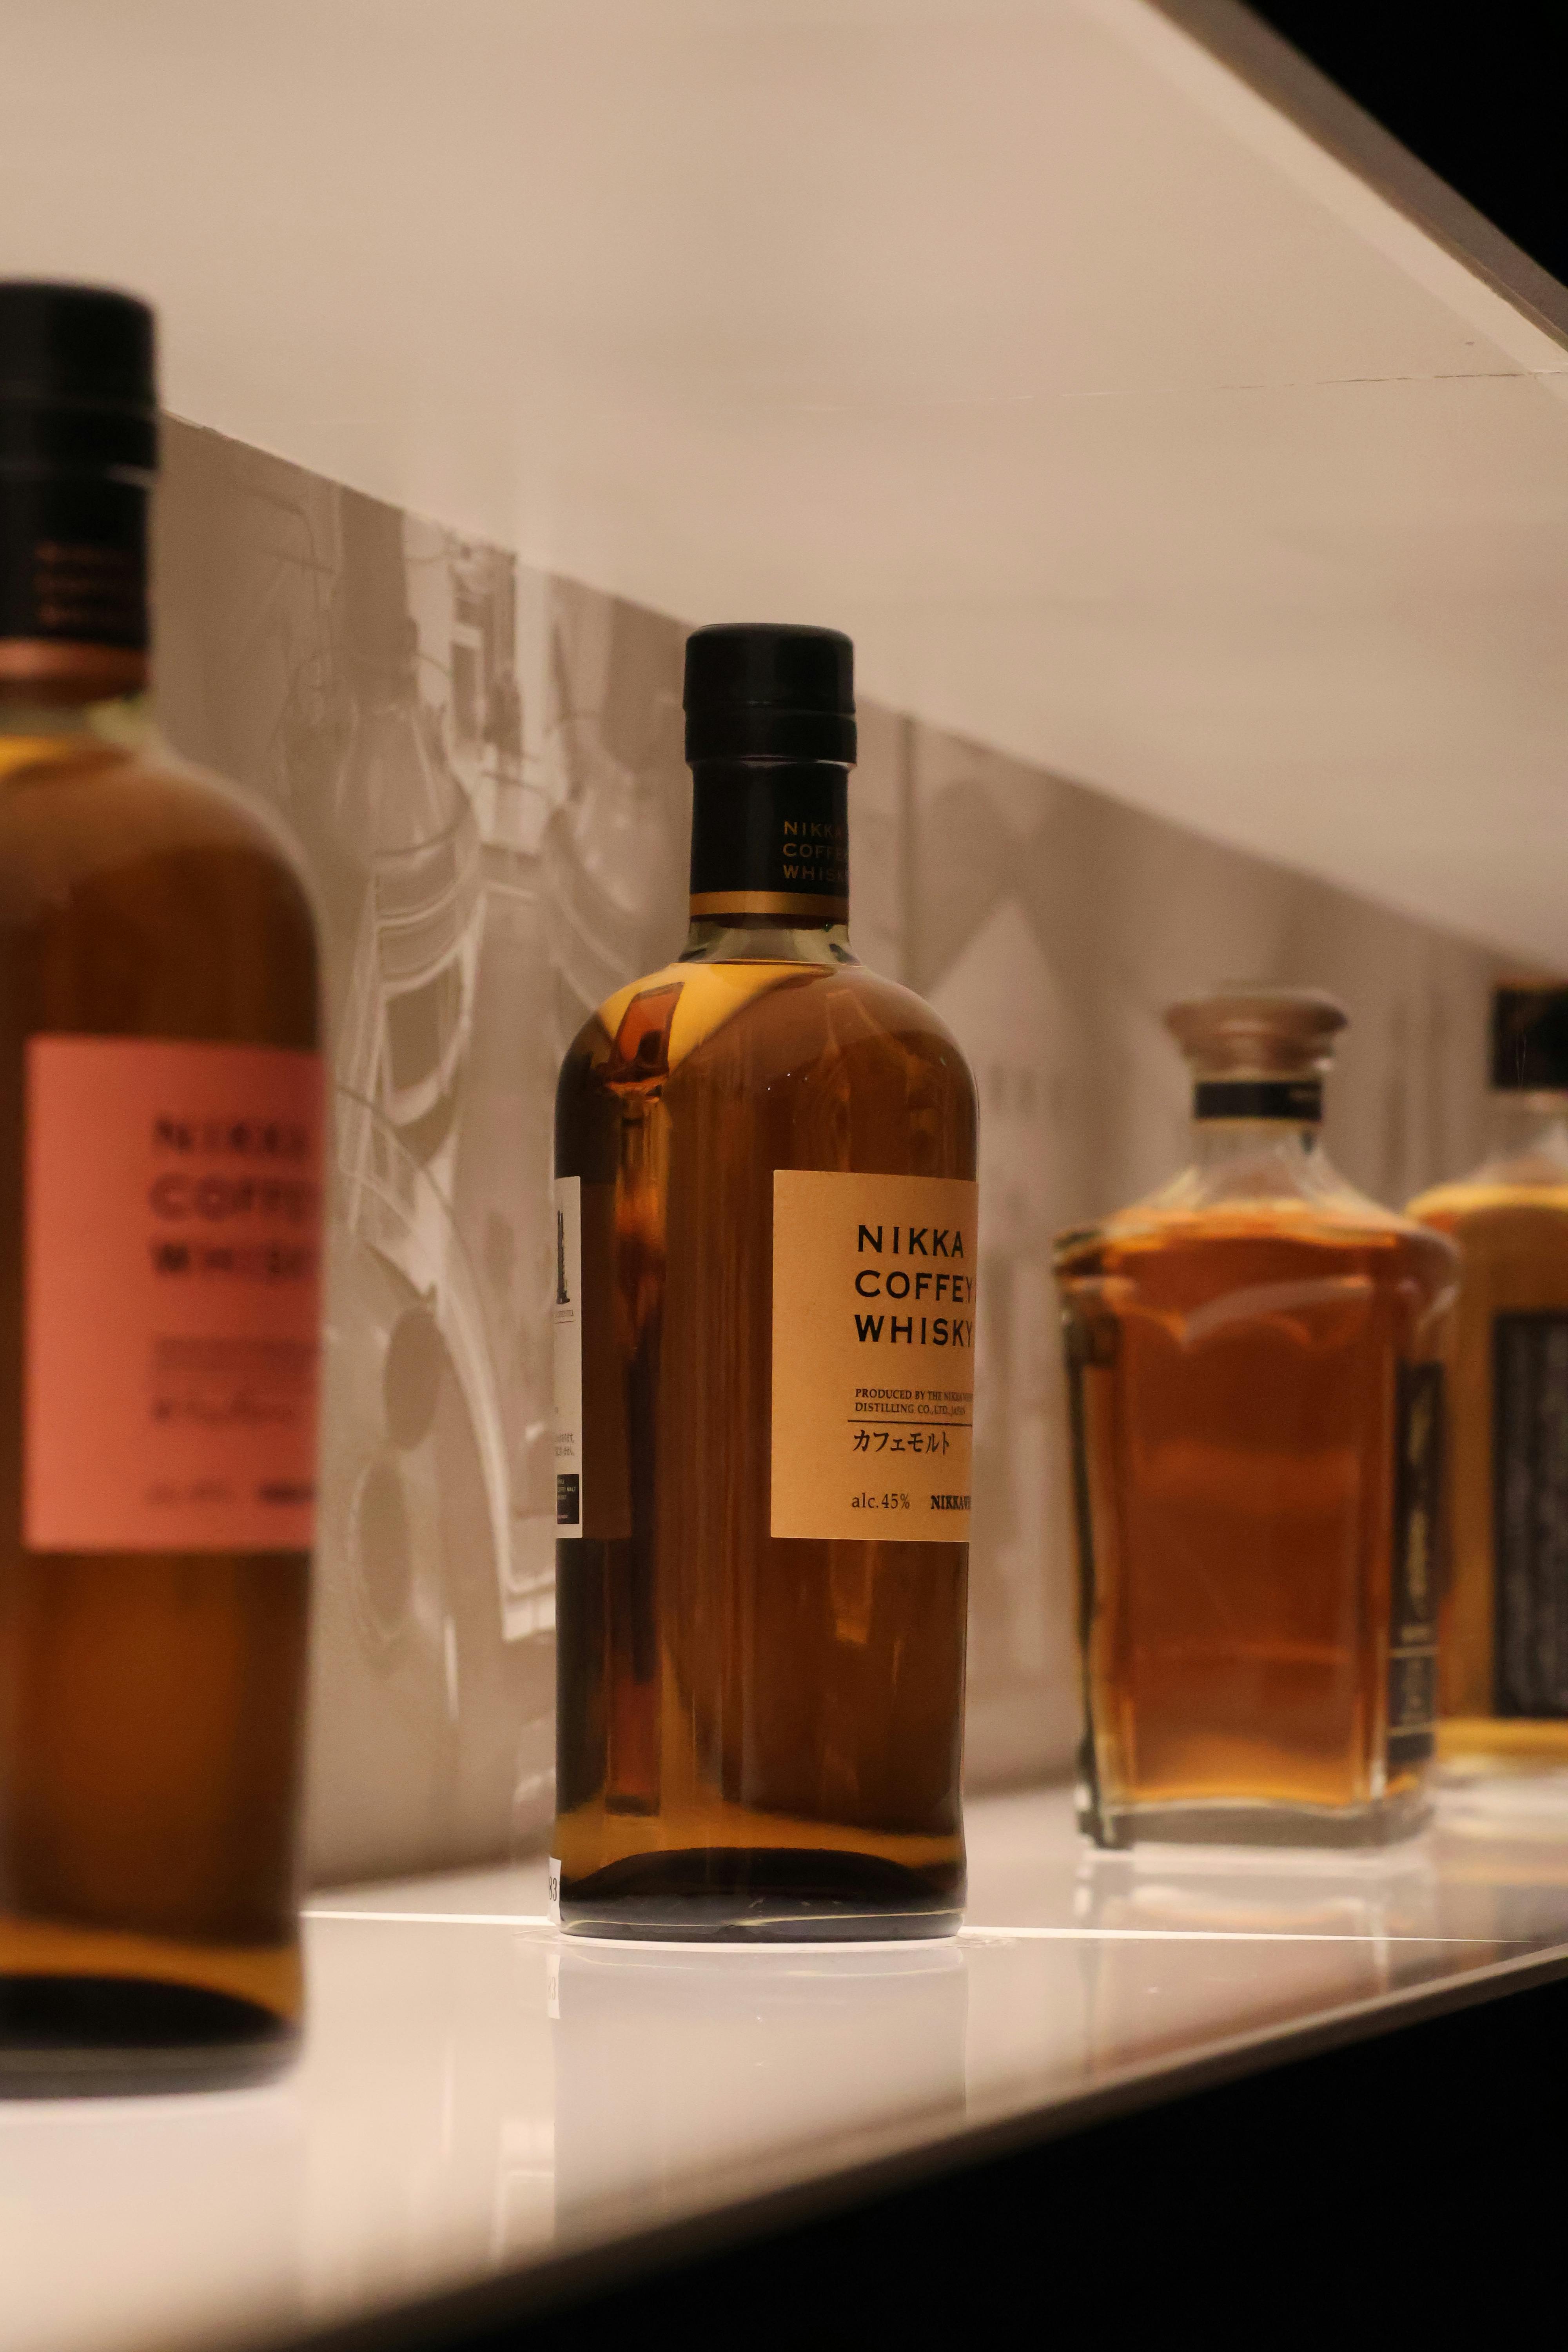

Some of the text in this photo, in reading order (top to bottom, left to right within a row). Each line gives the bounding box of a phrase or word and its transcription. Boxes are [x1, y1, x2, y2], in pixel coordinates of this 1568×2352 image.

[782, 842, 846, 861] COFFE
[857, 1225, 964, 1258] NIKKA
[855, 1269, 973, 1303] COFFEY
[854, 1314, 973, 1348] WHISKY
[855, 1388, 912, 1400] PRODUCED
[915, 1390, 925, 1400] BY
[927, 1391, 941, 1401] THE
[855, 1402, 914, 1413] DISTILLING
[853, 1429, 949, 1456] カフェモルト
